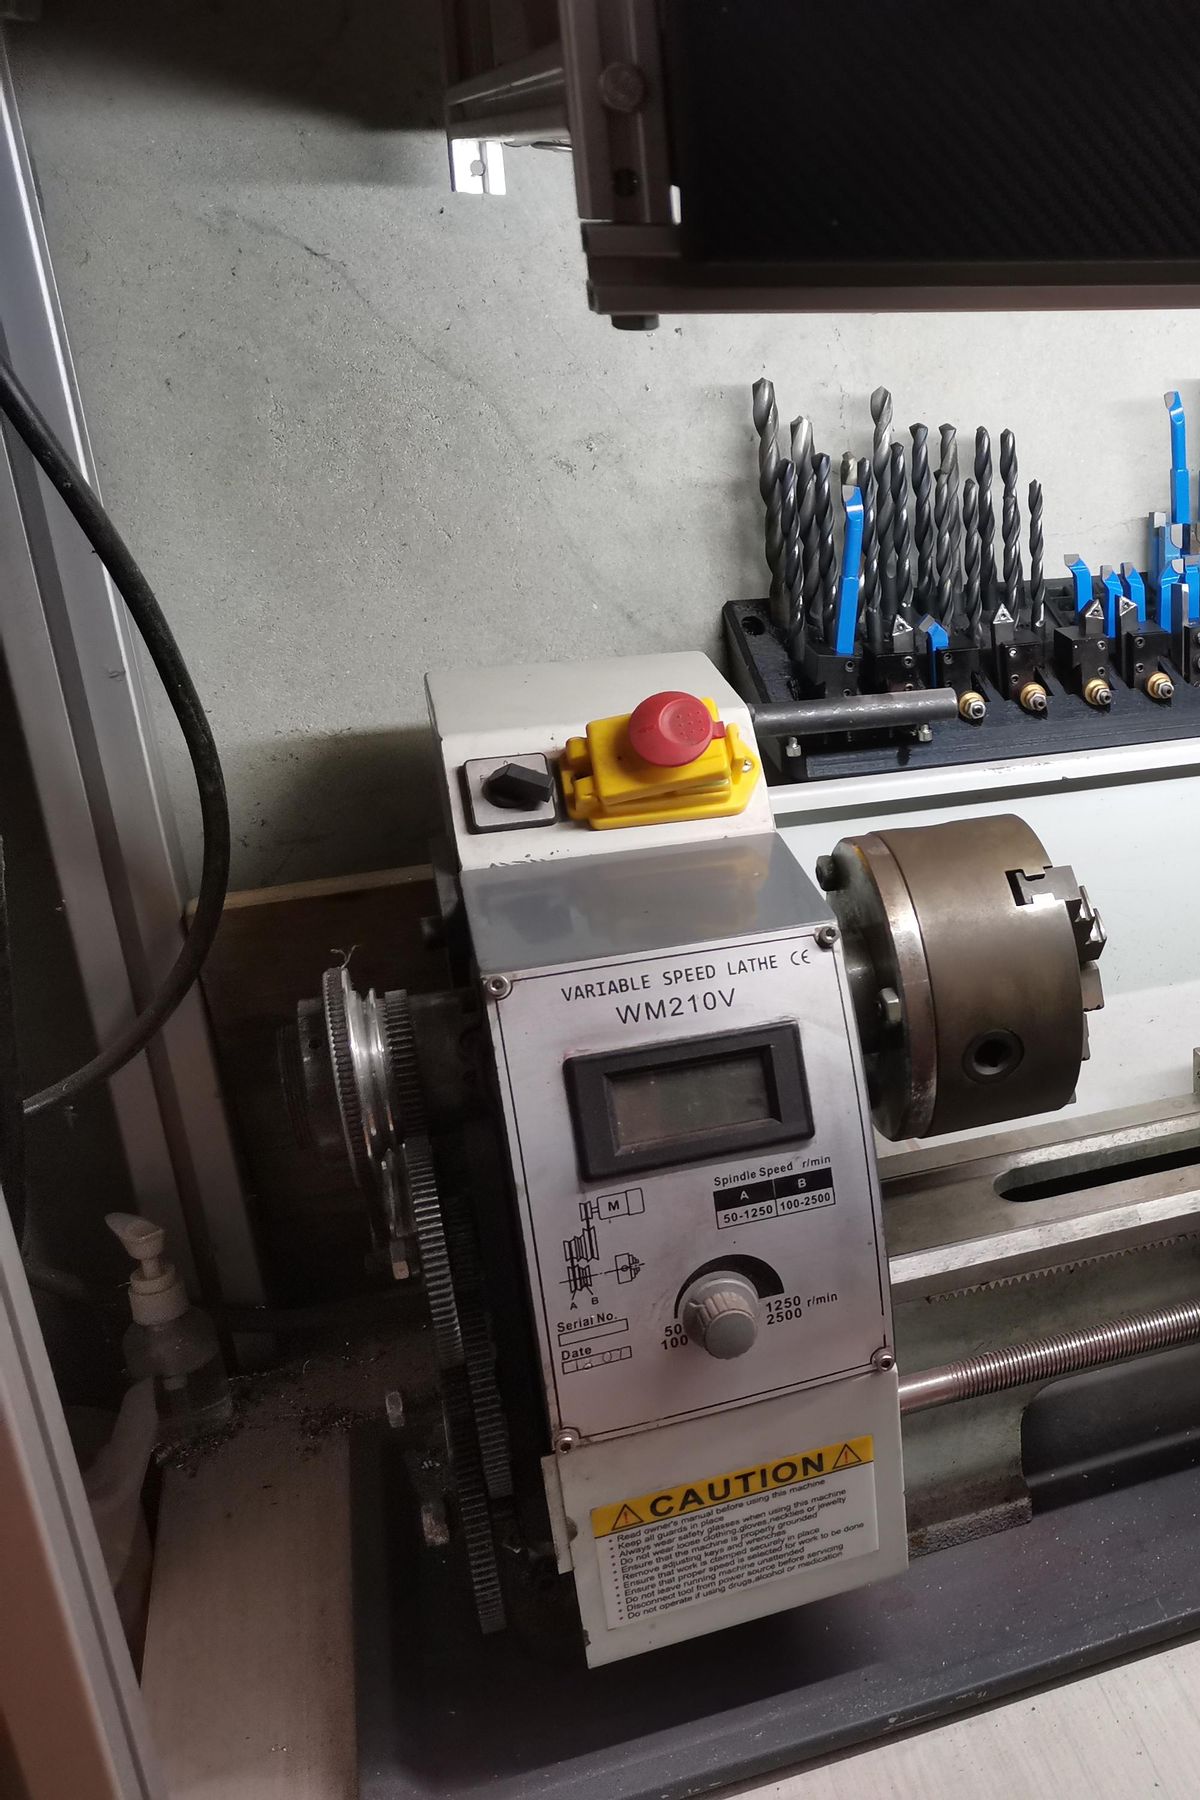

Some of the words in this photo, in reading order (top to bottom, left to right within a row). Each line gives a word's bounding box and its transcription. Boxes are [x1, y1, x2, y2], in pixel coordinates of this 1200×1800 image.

[561, 974, 651, 1002] VARIABLE
[662, 963, 717, 986] SPEED
[727, 954, 779, 978] LATHE
[615, 987, 737, 1025] WM210V
[713, 1171, 757, 1187] Spindle
[759, 1162, 793, 1177] Speed
[802, 1155, 831, 1169] r/min
[607, 1199, 621, 1212] M
[739, 1190, 749, 1200] A
[797, 1178, 807, 1189] B
[723, 1204, 773, 1224] 50-1250
[780, 1192, 831, 1211] 100-2500
[570, 1302, 578, 1311] A
[591, 1295, 600, 1305] B
[765, 1295, 801, 1312] 1250
[806, 1291, 839, 1308] r/min
[766, 1307, 803, 1326] 2500
[557, 1316, 594, 1333] Serial
[597, 1312, 618, 1323] No.
[664, 1323, 683, 1338] 50
[561, 1346, 592, 1361] Date
[660, 1333, 689, 1351] 100
[649, 1452, 825, 1518] CAUTION
[616, 1529, 641, 1542] Read
[680, 1508, 713, 1524] manual
[715, 1502, 744, 1514] before
[745, 1494, 769, 1506] using
[771, 1489, 787, 1498] this
[789, 1479, 825, 1493] machine
[618, 1544, 651, 1558] Always
[653, 1536, 676, 1548] wear
[677, 1528, 704, 1541] safety
[706, 1519, 740, 1534] glasses
[742, 1511, 766, 1522] when
[768, 1504, 791, 1515] using
[793, 1499, 808, 1508] this
[810, 1488, 846, 1503] machine
[617, 1538, 642, 1549] Keep
[644, 1533, 654, 1542] all
[656, 1525, 688, 1540] guards
[700, 1515, 724, 1528] place
[620, 1559, 653, 1573] Ensure
[655, 1553, 673, 1563] that
[674, 1549, 689, 1558] the
[690, 1538, 728, 1553] machine
[777, 1511, 817, 1530] grounded
[619, 1556, 633, 1565] Do
[635, 1551, 650, 1561] not
[651, 1545, 674, 1556] wear
[676, 1538, 700, 1549] loose
[622, 1565, 660, 1581] Remove
[661, 1553, 701, 1570] adjusting
[703, 1547, 724, 1557] keys
[726, 1540, 743, 1551] and
[744, 1529, 786, 1545] wrenches
[622, 1575, 655, 1588] Ensure
[657, 1568, 674, 1579] that
[676, 1562, 697, 1573] work
[749, 1537, 786, 1552] securely
[797, 1527, 819, 1540] place
[624, 1582, 656, 1596] Ensure
[658, 1576, 675, 1586] that
[677, 1567, 706, 1582] proper
[708, 1558, 735, 1572] speed
[737, 1556, 744, 1564] is
[746, 1544, 782, 1560] selected
[784, 1541, 796, 1549] for
[797, 1535, 818, 1545] work
[830, 1528, 841, 1536] be
[843, 1522, 864, 1532] done
[624, 1595, 638, 1604] Do
[640, 1589, 655, 1599] not
[656, 1581, 681, 1595] leave
[682, 1573, 716, 1587] running
[718, 1561, 755, 1577] machine
[756, 1546, 804, 1566] unattended
[626, 1591, 675, 1611] Disconnect
[677, 1586, 694, 1597] tool
[696, 1581, 716, 1591] from
[718, 1572, 745, 1586] power
[746, 1563, 775, 1576] source
[777, 1554, 804, 1567] before
[627, 1610, 641, 1619] Do
[642, 1605, 656, 1614] not
[658, 1595, 692, 1609] operate
[702, 1585, 726, 1597] using
